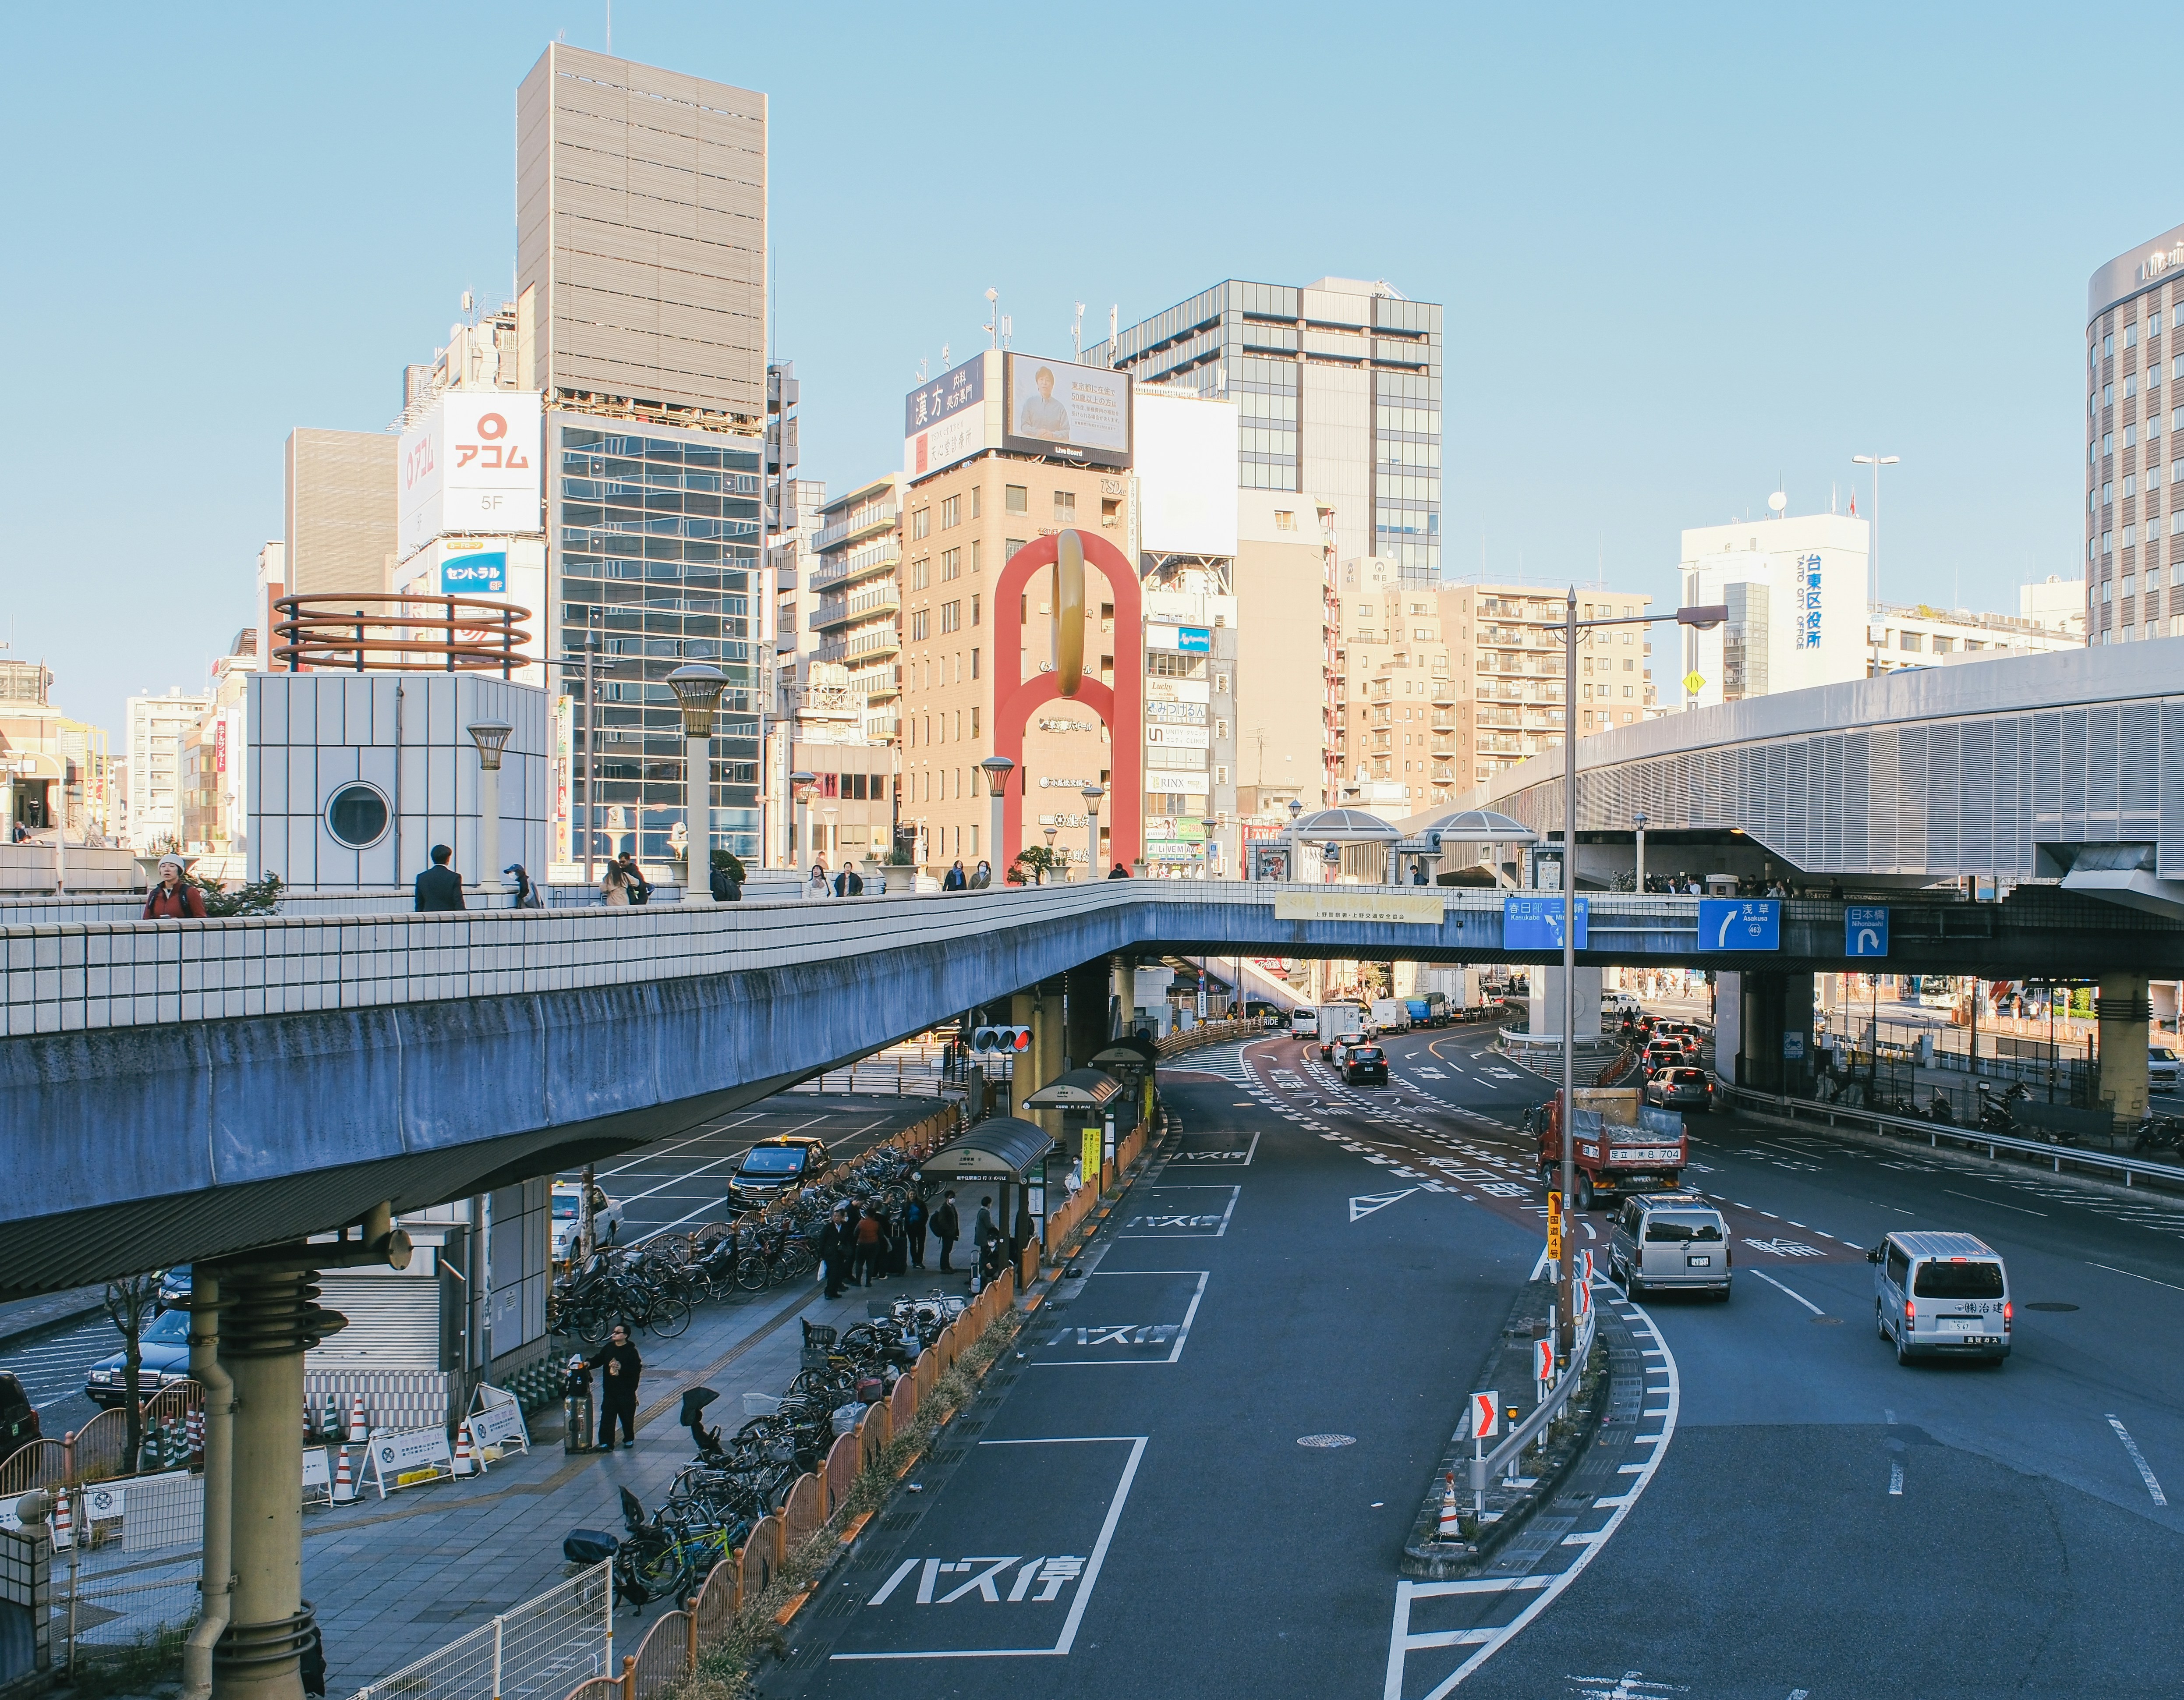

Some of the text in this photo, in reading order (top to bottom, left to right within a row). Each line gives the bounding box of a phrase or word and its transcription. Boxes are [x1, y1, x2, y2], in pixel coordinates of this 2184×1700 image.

[916, 384, 944, 426] 漢方
[1072, 393, 1116, 407] 50歳以上の方は
[414, 434, 434, 484] アコム
[455, 445, 529, 468] アコム
[1101, 479, 1121, 495] TSD
[481, 496, 503, 510] 5F
[446, 567, 500, 580] セントラル
[489, 581, 503, 591] 5F
[1805, 553, 1822, 649] 台東区役所
[1152, 682, 1172, 691] Lucky
[1157, 702, 1205, 717] みつけるん
[1161, 778, 1184, 788] RINX
[1508, 902, 1543, 914] 春日部
[1550, 902, 1584, 914] 三輪
[1742, 903, 1770, 915] 浅草
[1315, 912, 1405, 920] 上野警察署・上野交通安全協会
[1851, 909, 1885, 921] 日本橋
[1172, 1151, 1248, 1160] バス停
[1611, 1151, 1628, 1159] 足立
[1648, 1151, 1654, 1159] 8
[1126, 1215, 1222, 1227] バス停
[1550, 1216, 1559, 1258] 国道4号
[1046, 1324, 1181, 1346] バス停
[867, 1555, 1087, 1605] バス停
